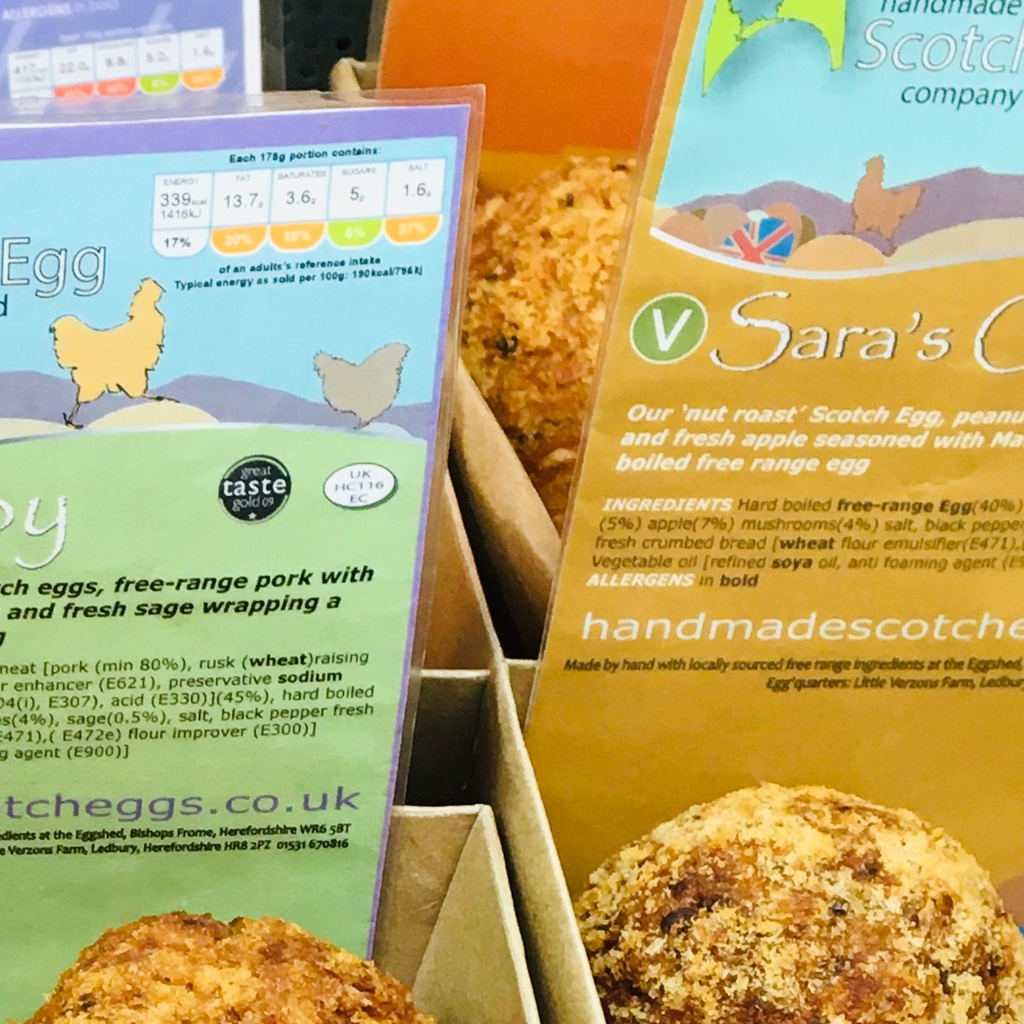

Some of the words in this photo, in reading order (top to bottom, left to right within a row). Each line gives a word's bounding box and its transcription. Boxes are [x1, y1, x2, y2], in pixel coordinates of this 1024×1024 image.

[901, 85, 1023, 112] company
[229, 154, 256, 164] Each
[289, 150, 328, 162] portion
[164, 237, 191, 248] 17%
[0, 237, 107, 298] Egg
[709, 291, 951, 371] Sara's
[627, 404, 674, 422] Our
[808, 405, 890, 424] Scotch
[896, 406, 945, 428] Egg,
[620, 429, 669, 446] and
[673, 429, 736, 447] fresh
[741, 430, 809, 451] apple
[813, 431, 930, 448] seasoned
[933, 431, 985, 449] with
[241, 466, 272, 479] great
[350, 470, 371, 479] UK
[615, 453, 692, 471] boiled
[696, 453, 745, 472] free
[750, 457, 820, 475] range
[826, 458, 871, 476] egg
[223, 478, 287, 496] taste
[232, 496, 260, 511] gold
[602, 498, 733, 512] INGREDIENTS
[737, 498, 778, 512] Hard
[782, 498, 832, 512] boiled
[837, 498, 934, 516] free-range
[37, 581, 104, 597] eggs,
[114, 576, 249, 593] free-range
[254, 569, 313, 592] pork
[321, 565, 374, 585] with
[586, 573, 695, 587] ALLERGENS
[699, 575, 714, 587] in
[720, 574, 759, 587] bold
[7, 600, 56, 620] and
[62, 600, 127, 619] fresh
[134, 602, 194, 619] sage
[203, 593, 320, 617] wrapping
[326, 596, 342, 609] a
[582, 612, 1024, 641] handmadescotche
[43, 660, 88, 675] [pork
[95, 660, 133, 674] (min
[140, 657, 191, 672] 80%),
[199, 656, 235, 670] rusk
[242, 652, 369, 670] (wheat)raising
[13, 678, 93, 692] enhancer
[99, 673, 161, 691] (E621),
[168, 674, 272, 690] preservative
[277, 670, 343, 684] sodium
[67, 706, 171, 725] sage(0.5%),
[179, 705, 213, 723] salt,
[220, 705, 264, 721] black
[269, 707, 328, 721] pepper
[333, 703, 374, 717] fresh
